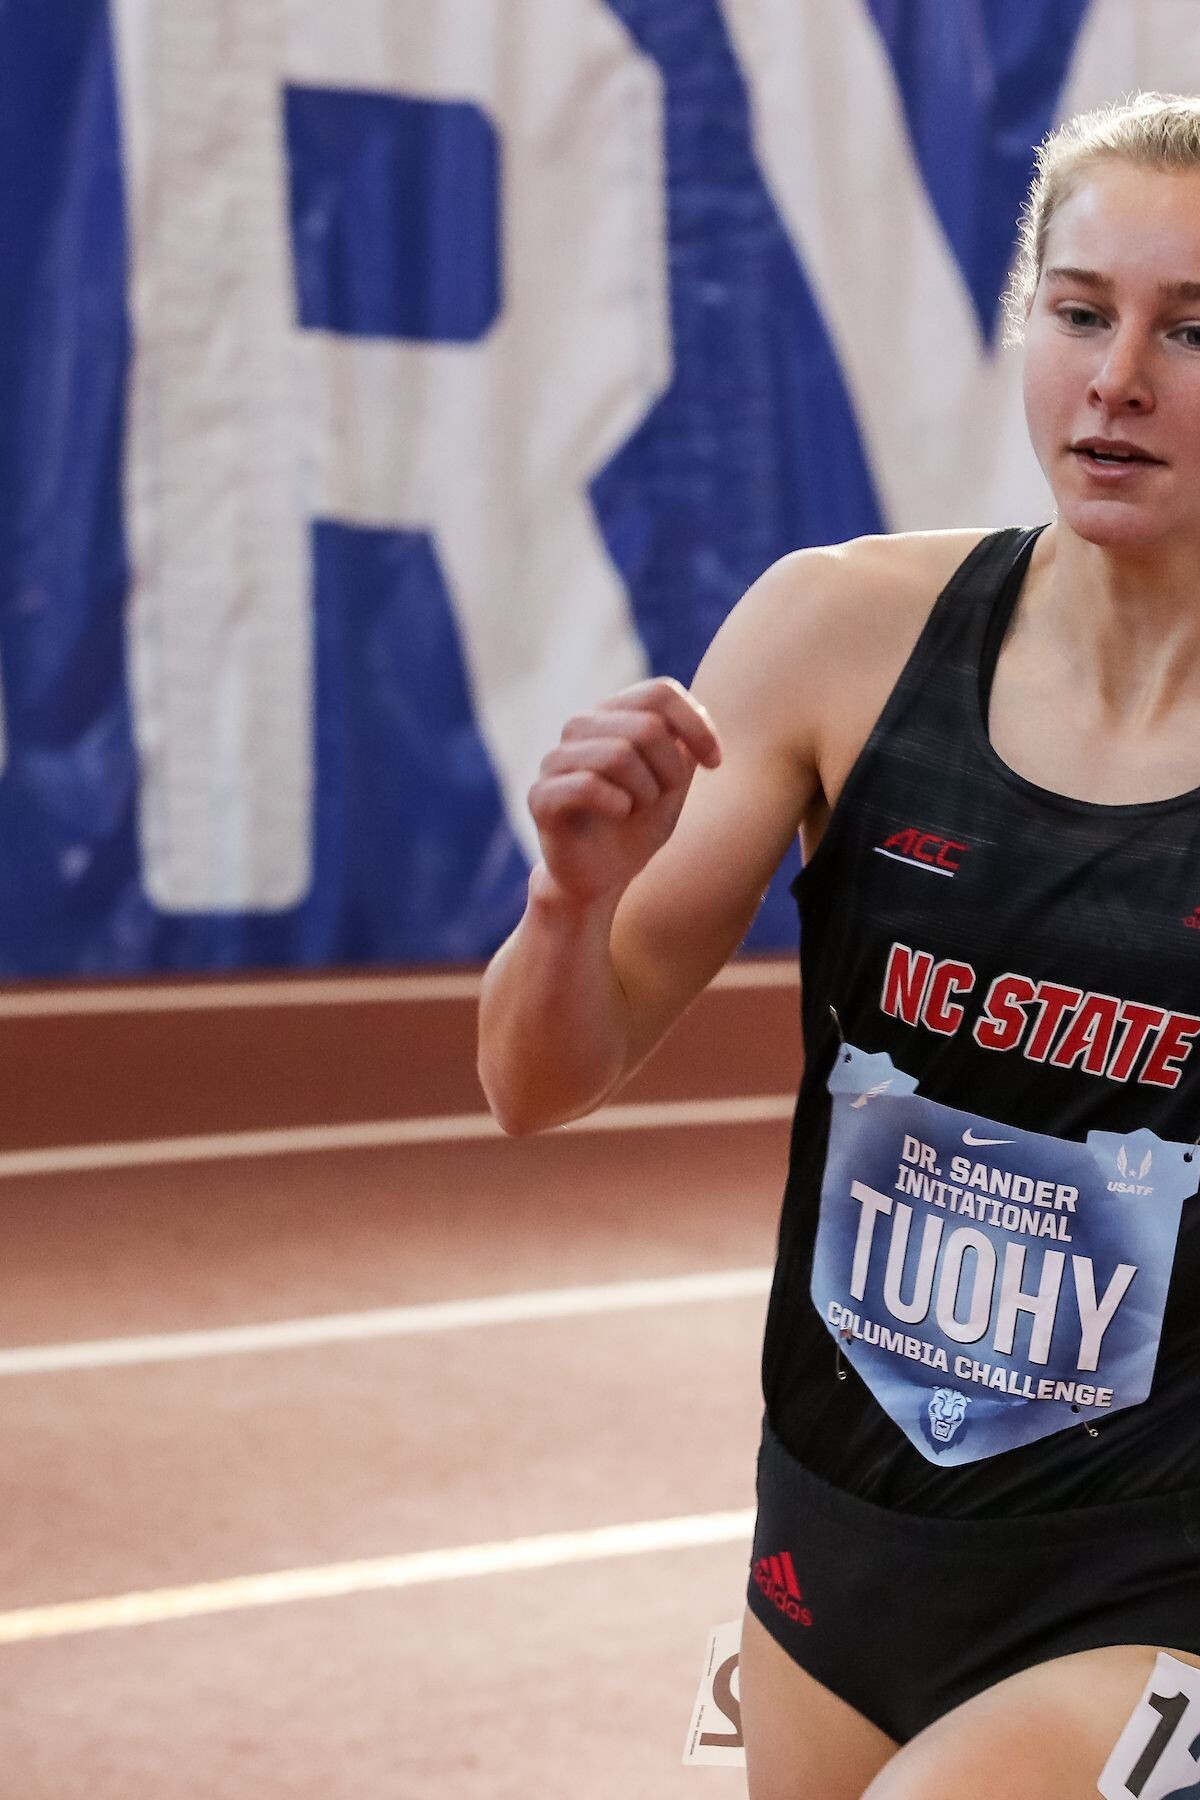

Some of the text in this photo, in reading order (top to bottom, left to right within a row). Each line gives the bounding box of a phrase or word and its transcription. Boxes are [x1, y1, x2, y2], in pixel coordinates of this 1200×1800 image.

[882, 828, 971, 870] ACC
[880, 943, 976, 1036] NC
[894, 1165, 1073, 1242] INVITATIONAL
[901, 1134, 1079, 1213] DR. SANDER
[1106, 1180, 1154, 1196] USATF
[848, 1178, 1139, 1373] TUOHY
[826, 1299, 1114, 1409] COLUMBIA CHALLENGE
[753, 1563, 813, 1627] adidas
